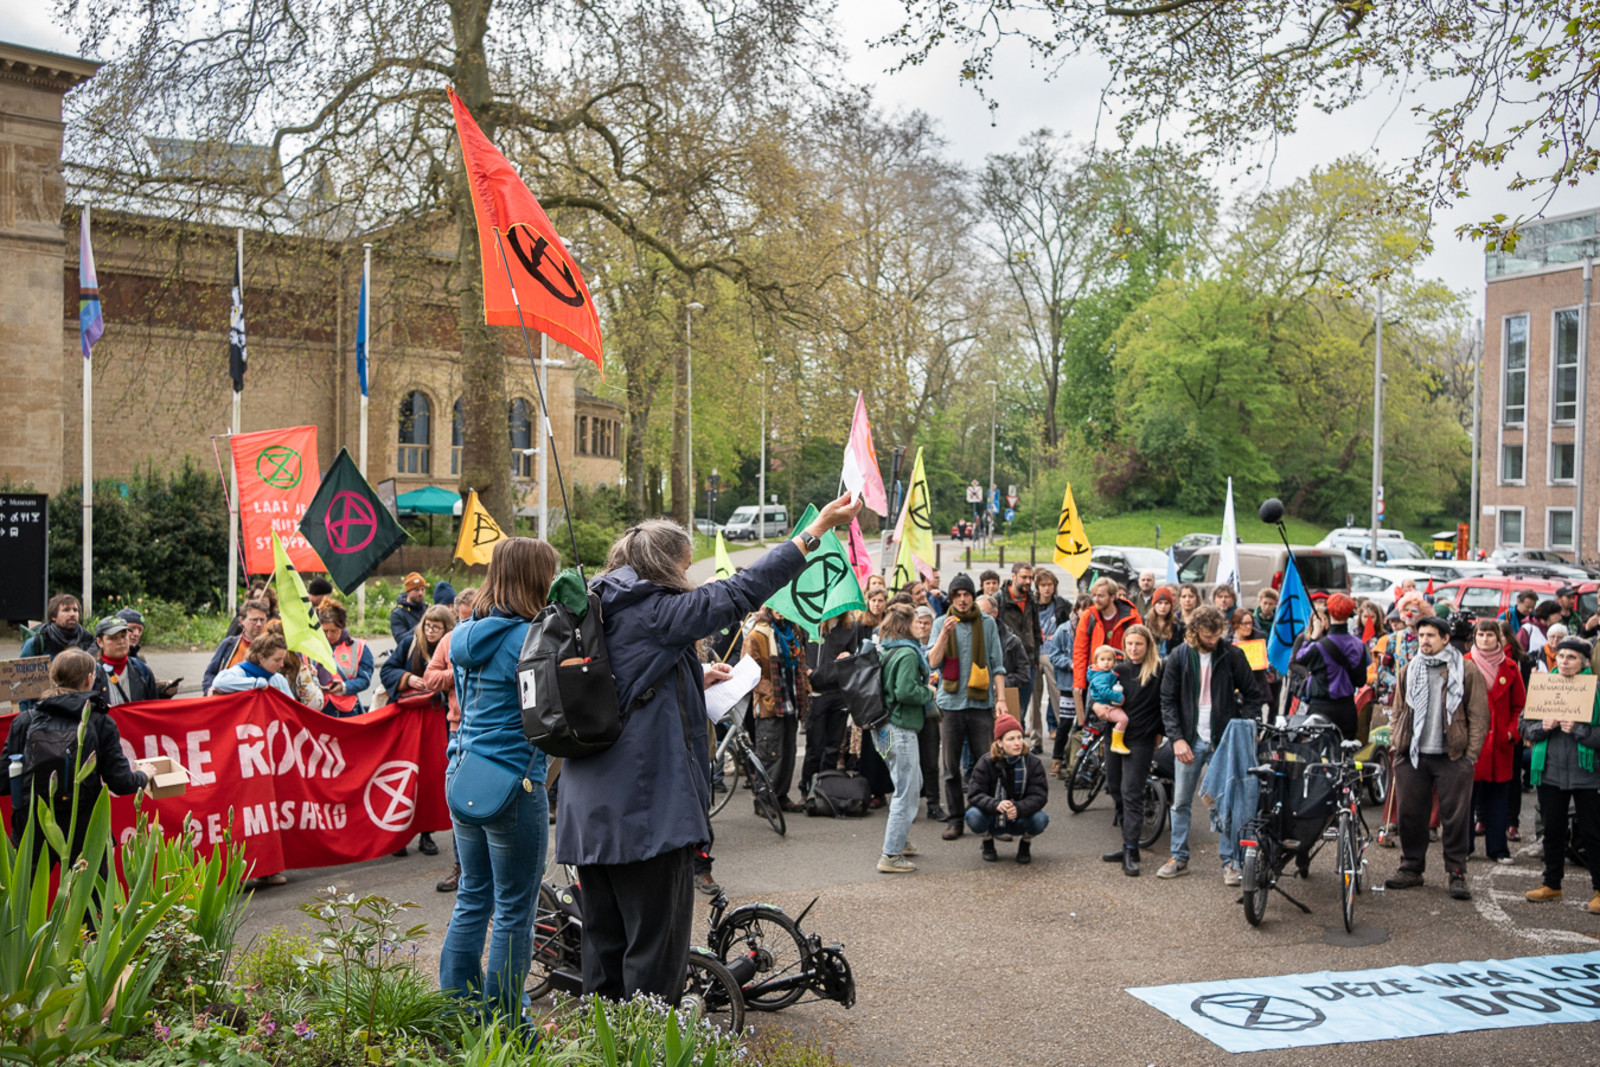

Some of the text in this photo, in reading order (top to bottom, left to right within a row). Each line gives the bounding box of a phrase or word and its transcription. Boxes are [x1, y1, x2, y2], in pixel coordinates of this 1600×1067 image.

[9, 498, 37, 506] Museum
[253, 500, 288, 514] LAAT
[1300, 978, 1425, 1002] DEZE
[1416, 970, 1534, 989] WEG
[1438, 984, 1600, 1016] DOO
